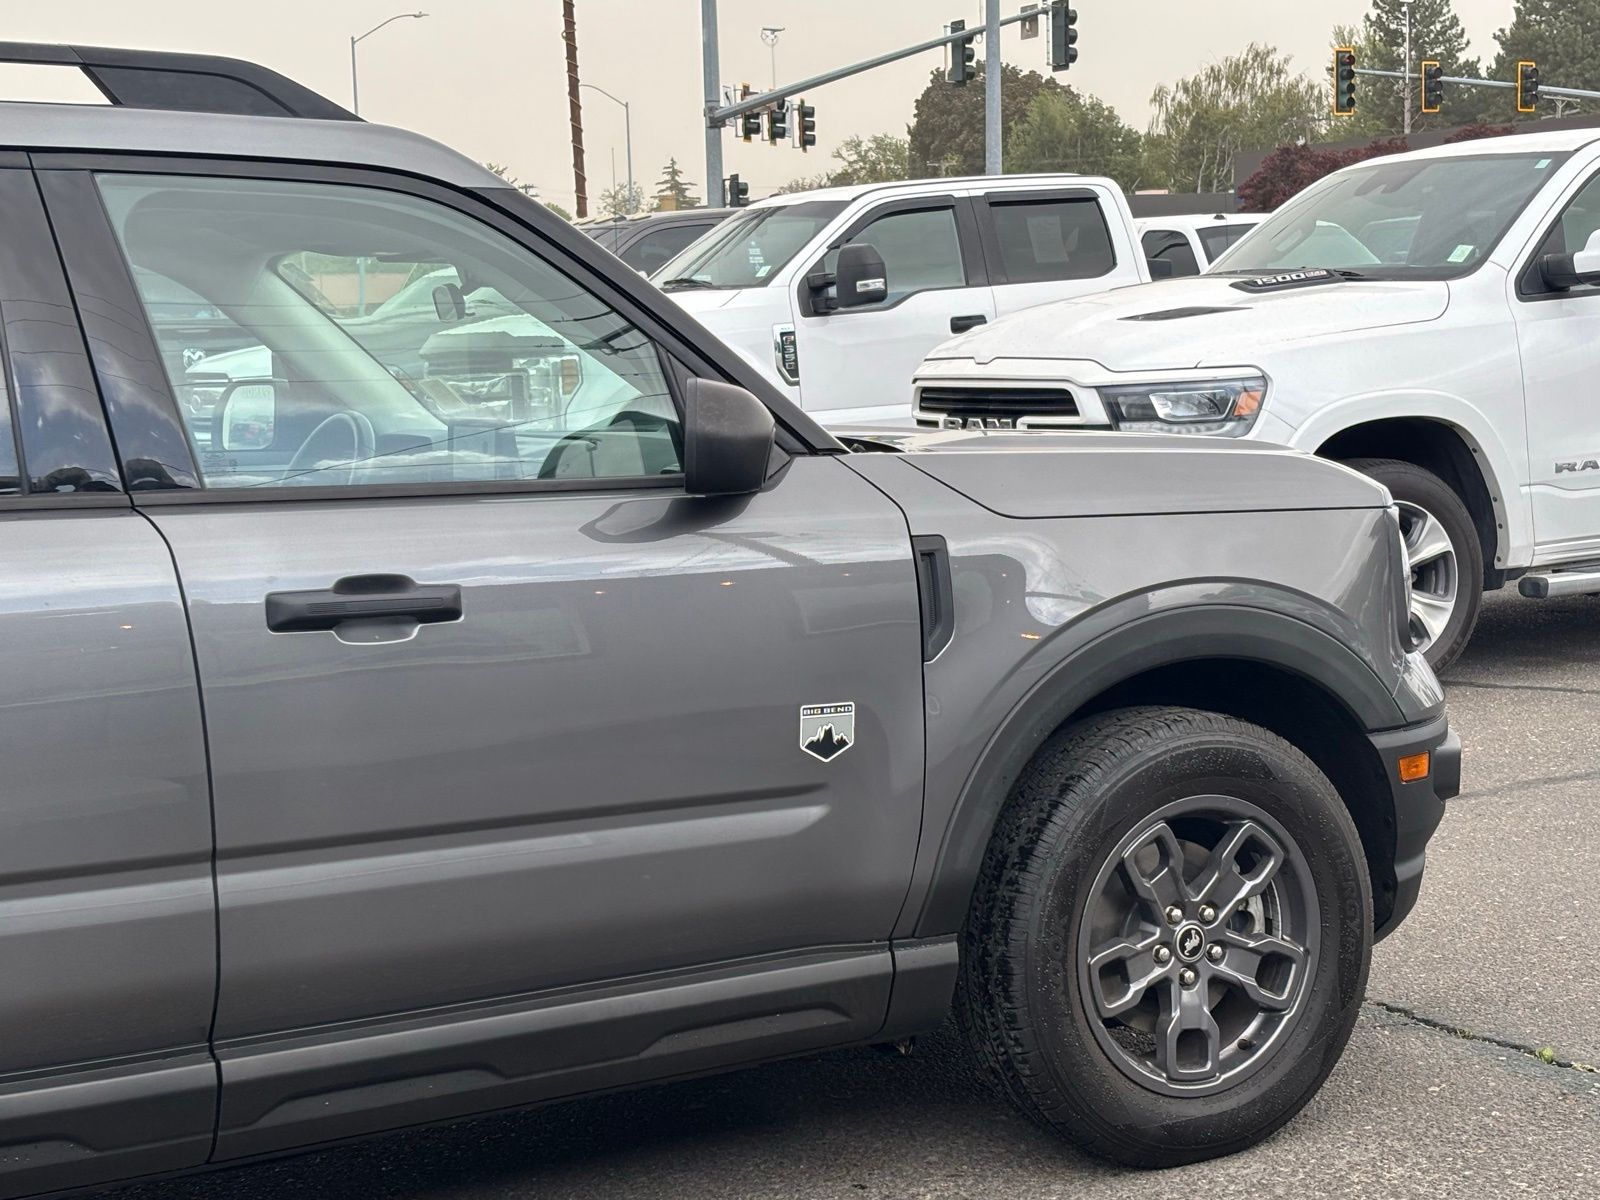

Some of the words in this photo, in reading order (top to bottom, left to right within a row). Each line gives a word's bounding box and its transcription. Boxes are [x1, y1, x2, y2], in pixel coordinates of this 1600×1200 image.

[1254, 273, 1306, 286] 1500
[942, 417, 1013, 431] RAM
[803, 708, 822, 716] BIG
[823, 706, 852, 714] BEND
